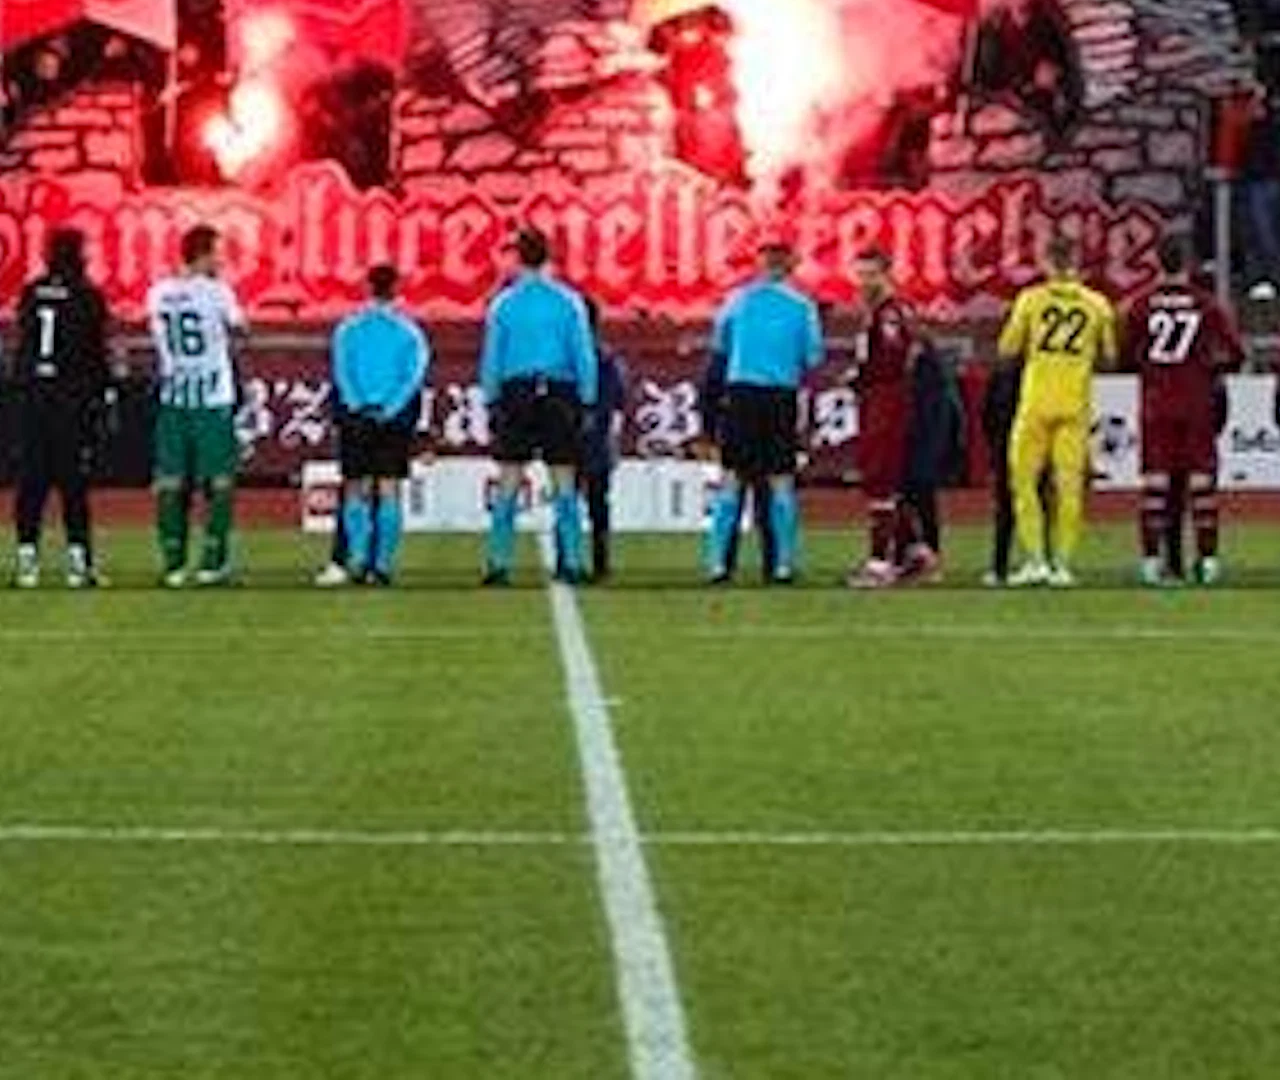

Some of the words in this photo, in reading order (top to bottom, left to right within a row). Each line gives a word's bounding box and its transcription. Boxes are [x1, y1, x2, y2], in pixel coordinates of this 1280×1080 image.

[36, 307, 56, 358] 1
[160, 310, 207, 358] 16
[1040, 307, 1088, 356] 22
[1148, 311, 1202, 363] 27
